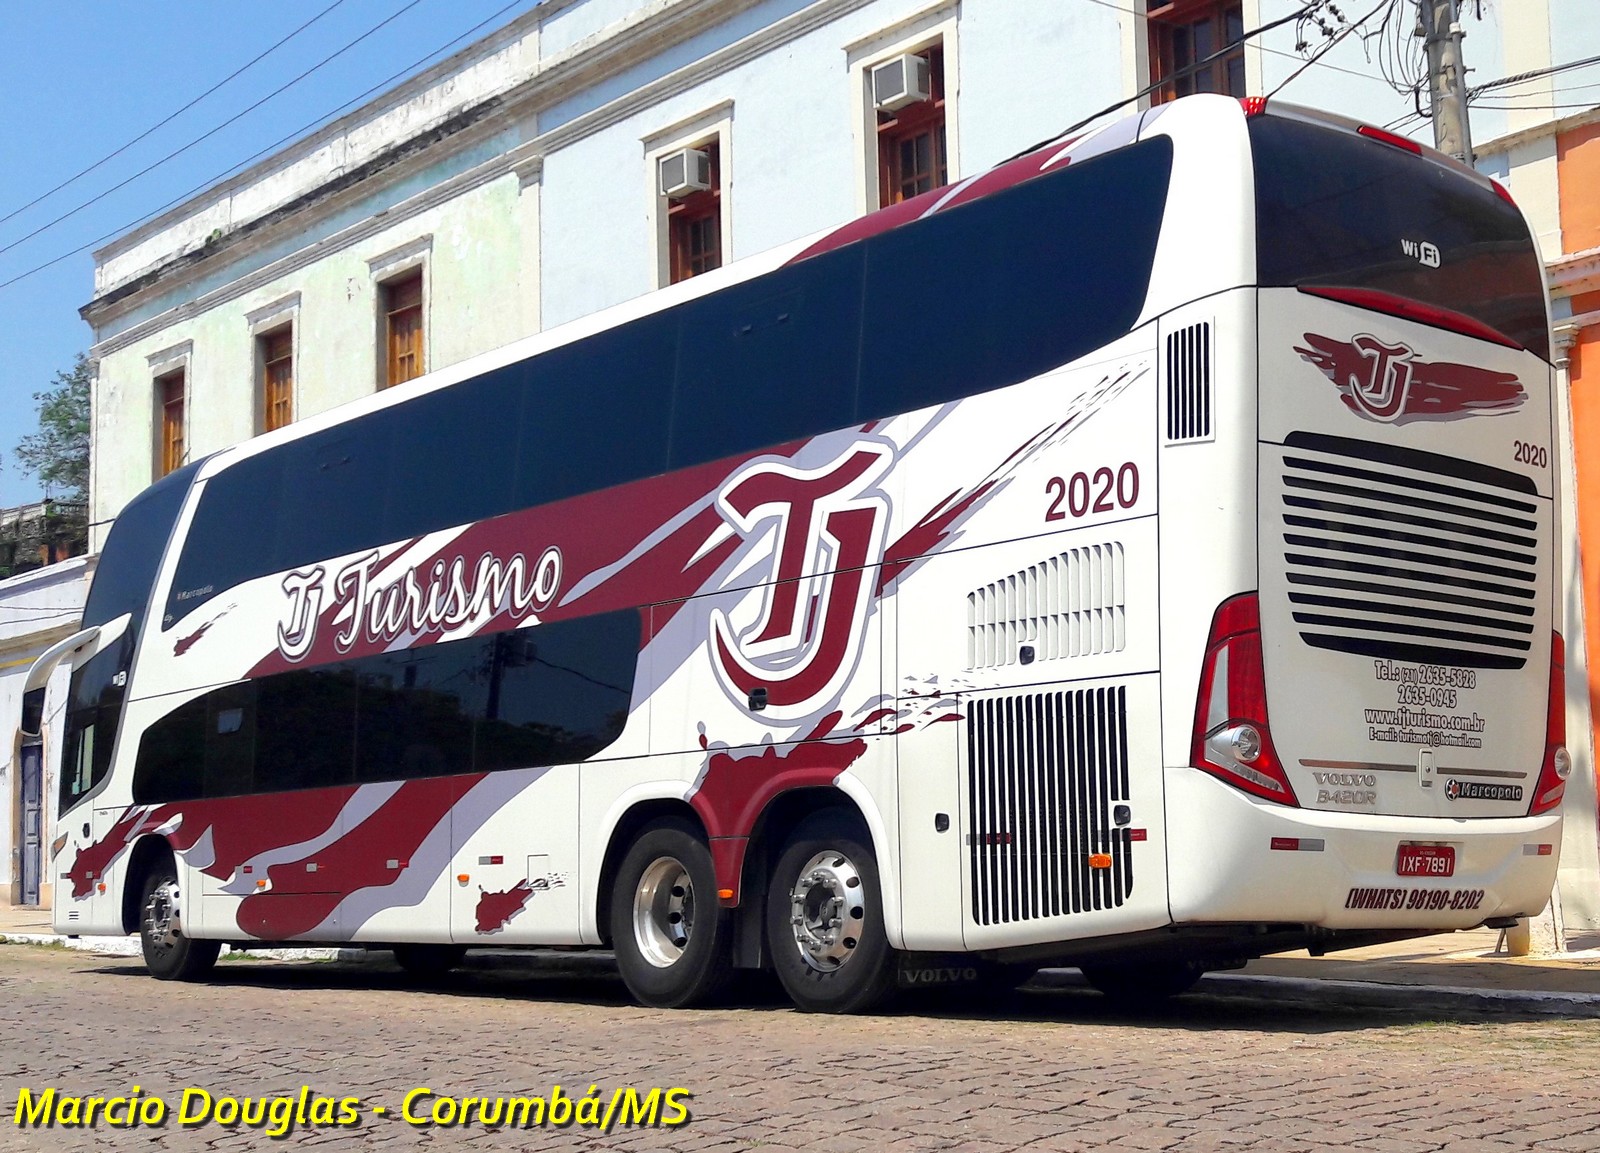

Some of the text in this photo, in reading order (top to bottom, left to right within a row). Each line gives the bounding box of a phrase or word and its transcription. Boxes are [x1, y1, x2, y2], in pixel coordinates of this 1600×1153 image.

[1400, 238, 1441, 268] WiFi
[1350, 332, 1415, 424] TJ
[1513, 440, 1548, 468] 2020
[1044, 461, 1140, 523] 2020
[708, 438, 894, 722] TJ
[334, 545, 563, 654] Turismo
[1374, 660, 1477, 689] Tel.: (21) 2635-5828
[1397, 684, 1458, 708] 2635-0945
[1364, 707, 1486, 733] www.tjturismo.com.br
[1368, 727, 1482, 748] E-mail: turismotj@hotmail.com
[1312, 772, 1377, 787] VOLVO
[1461, 782, 1523, 800] Marcopolo
[1406, 888, 1485, 911] 98190-8202
[903, 966, 978, 984] VOLVO
